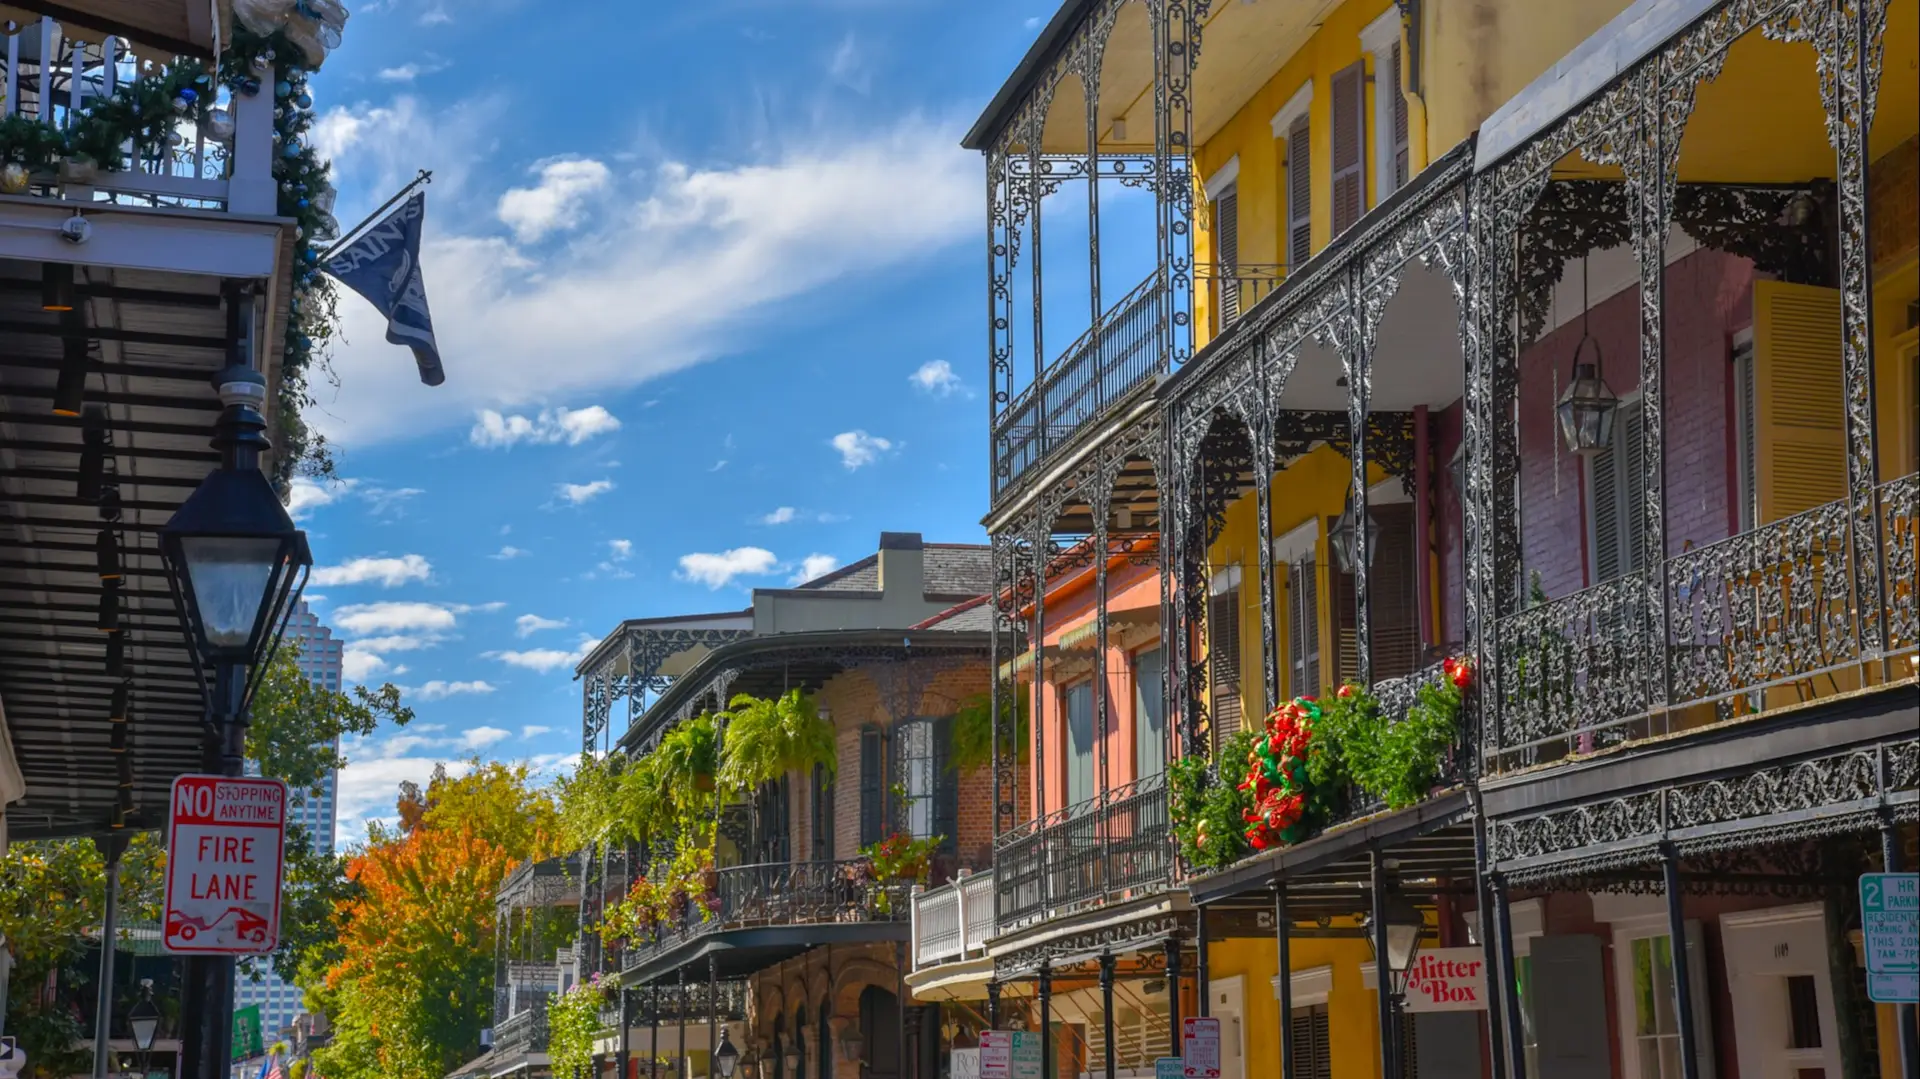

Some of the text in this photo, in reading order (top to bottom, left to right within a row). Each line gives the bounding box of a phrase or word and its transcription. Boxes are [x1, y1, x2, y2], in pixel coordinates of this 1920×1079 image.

[176, 784, 213, 818] NO
[217, 786, 280, 803] STOPPING
[219, 804, 275, 820] ANYTIME
[198, 836, 255, 863] FIRE
[191, 873, 257, 900] LANE
[1865, 883, 1880, 907] 2
[1897, 880, 1915, 893] HR
[1872, 937, 1894, 947] THIS
[1421, 980, 1477, 1003] Box
